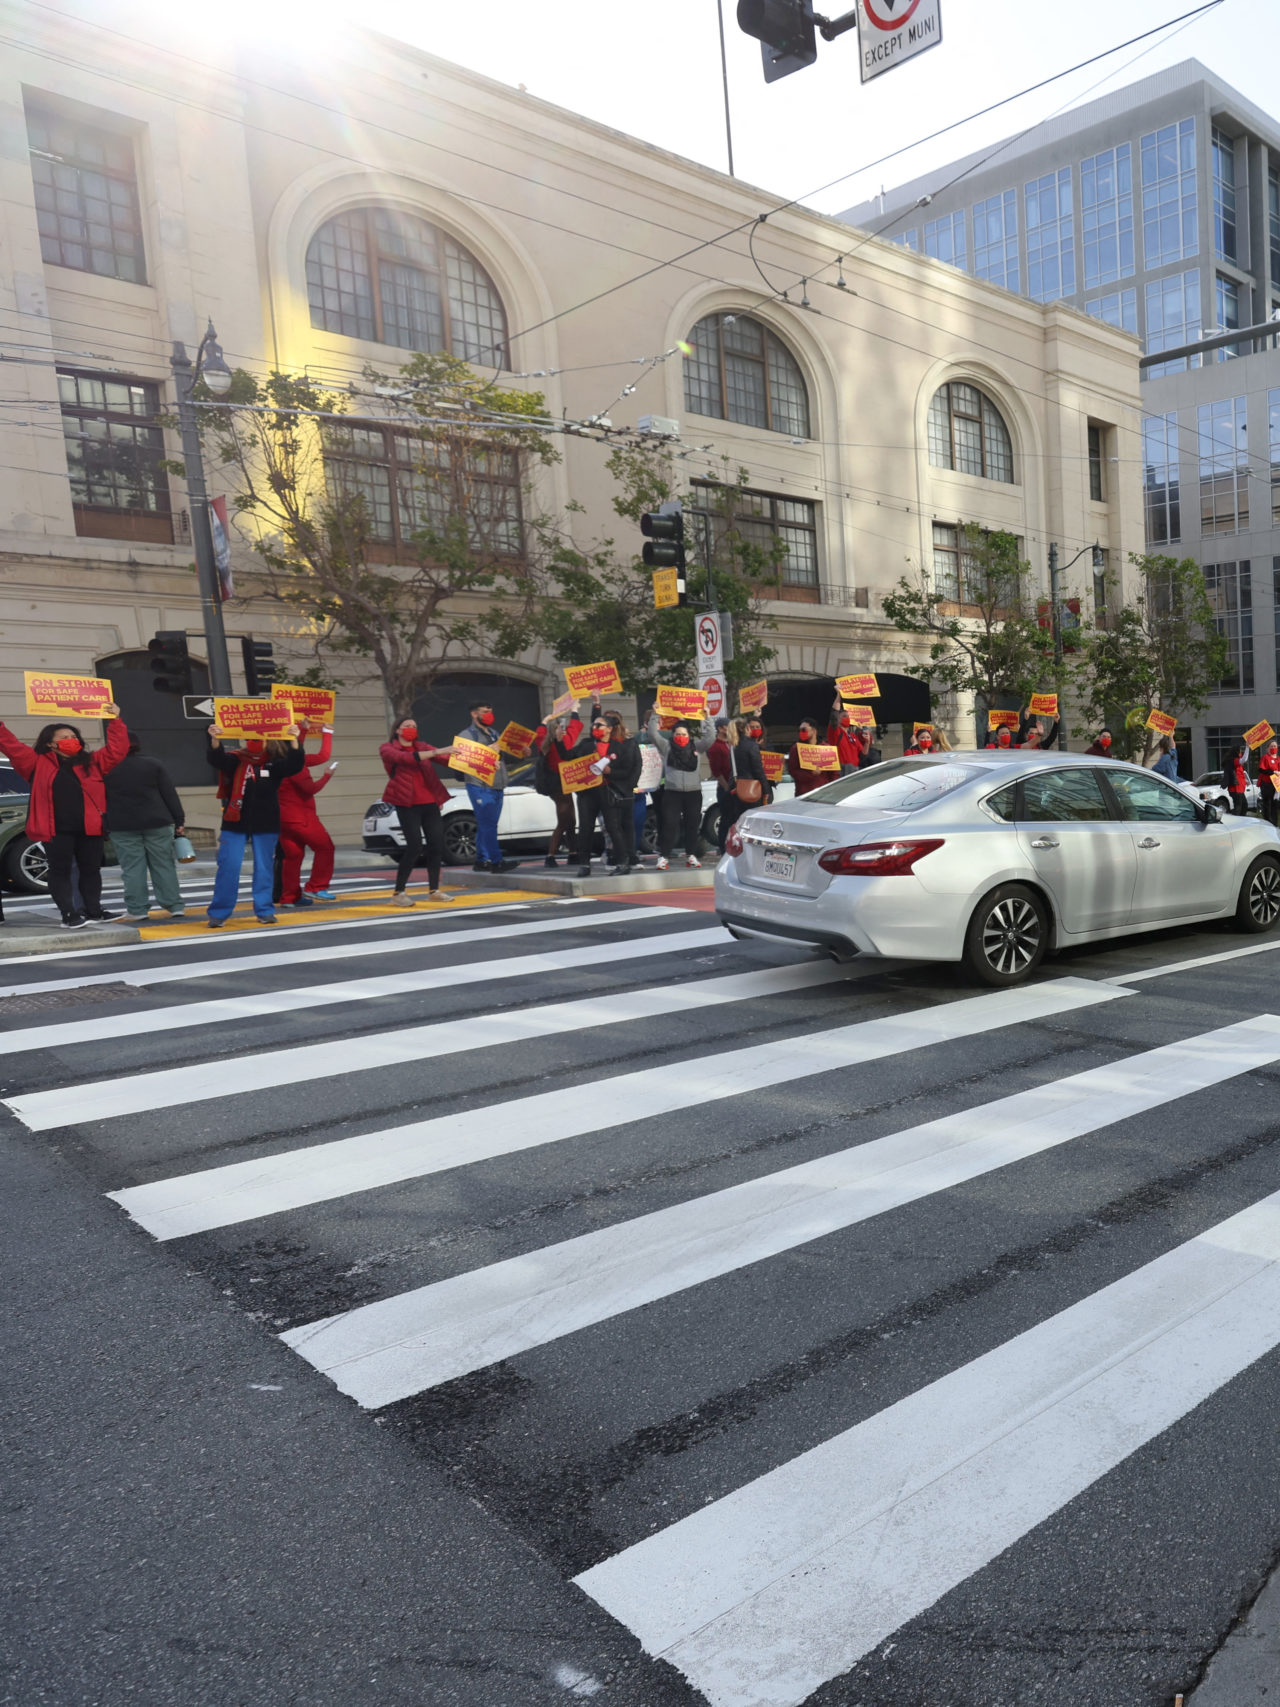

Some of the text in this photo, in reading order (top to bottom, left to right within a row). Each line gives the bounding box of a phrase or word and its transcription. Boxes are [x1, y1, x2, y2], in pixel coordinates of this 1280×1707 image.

[864, 15, 936, 68] EXCEPT MUNI
[31, 678, 104, 688] ON STRIKE
[36, 694, 108, 702] PATIENT CARE
[276, 689, 330, 698] ON STRIKE
[220, 704, 240, 713] ON
[243, 702, 286, 712] STRIKE
[224, 718, 263, 726] PATIENT
